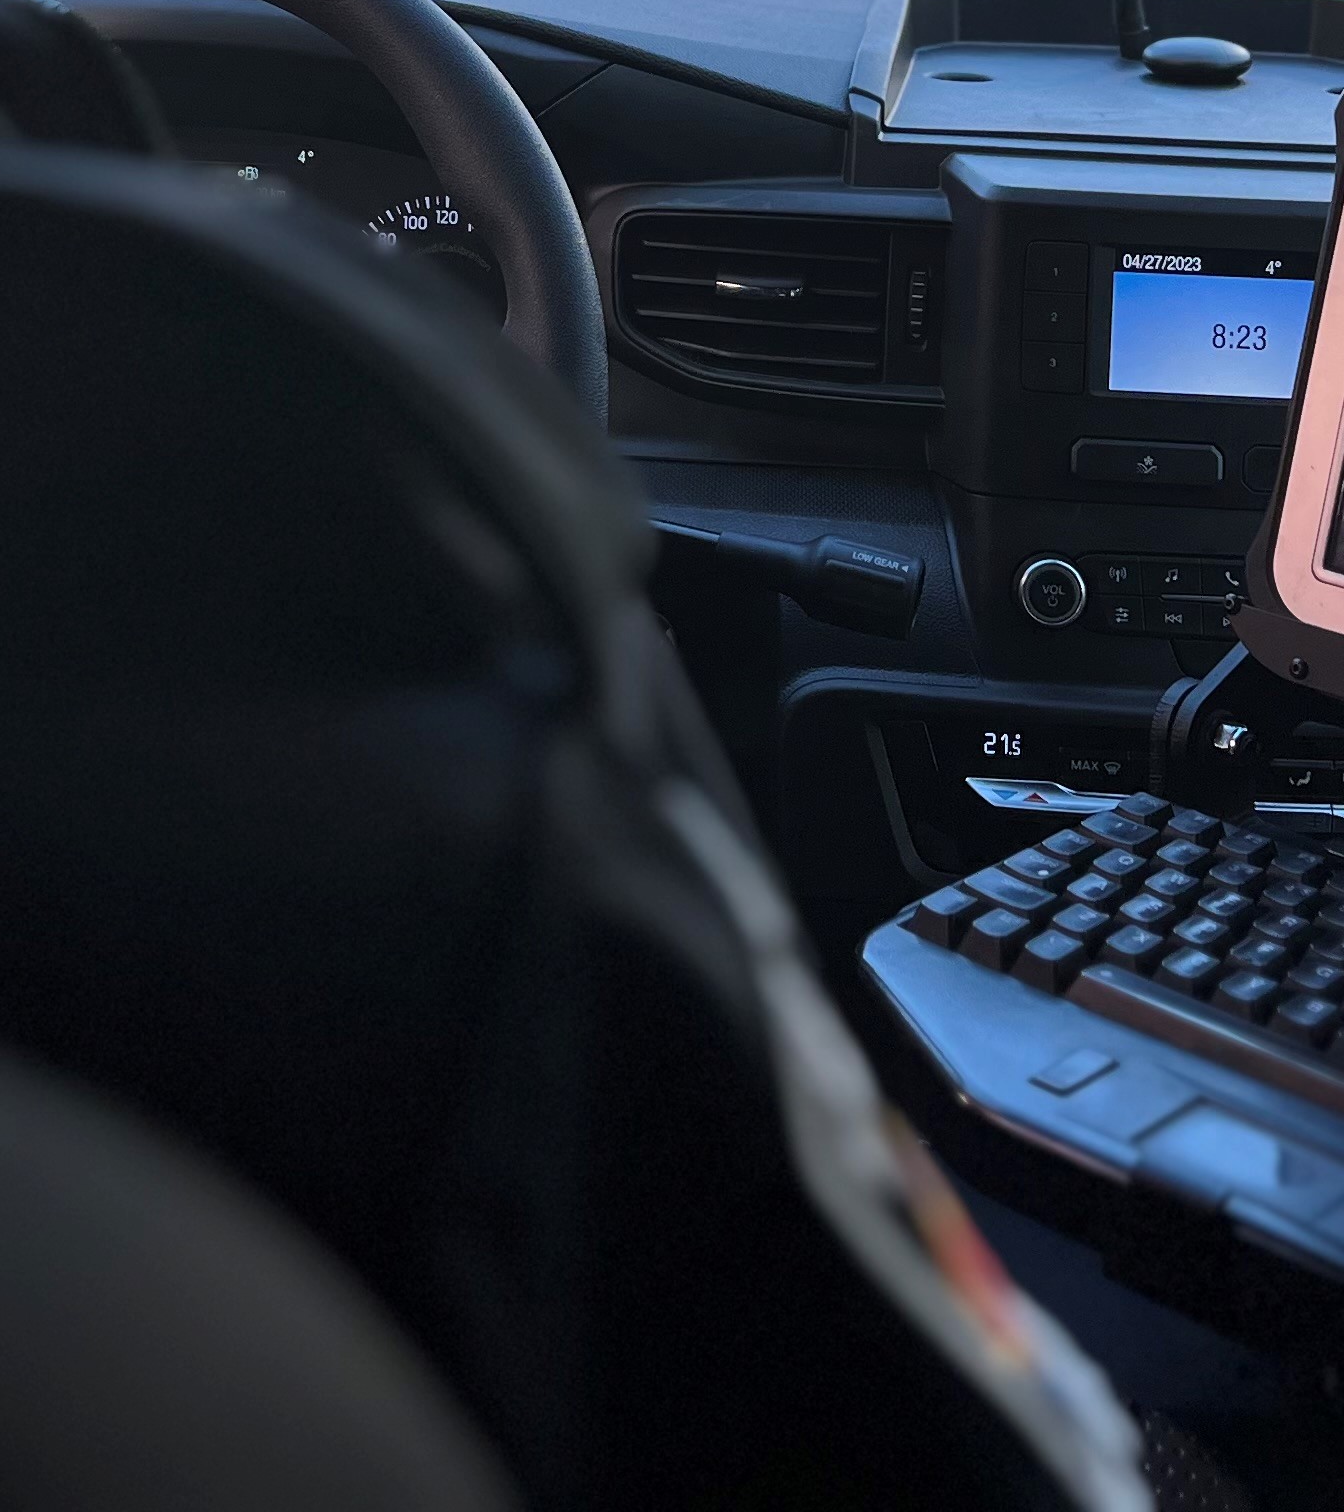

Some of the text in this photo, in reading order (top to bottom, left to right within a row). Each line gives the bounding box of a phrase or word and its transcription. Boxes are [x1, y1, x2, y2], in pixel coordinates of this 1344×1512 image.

[402, 215, 428, 231] 100
[435, 209, 459, 225] 120
[1123, 254, 1282, 275] 04/27/2023 4°
[1212, 323, 1267, 350] 8:23
[852, 551, 899, 570] LOW GEAR
[1042, 584, 1065, 595] VOL
[1070, 760, 1099, 773] MAX
